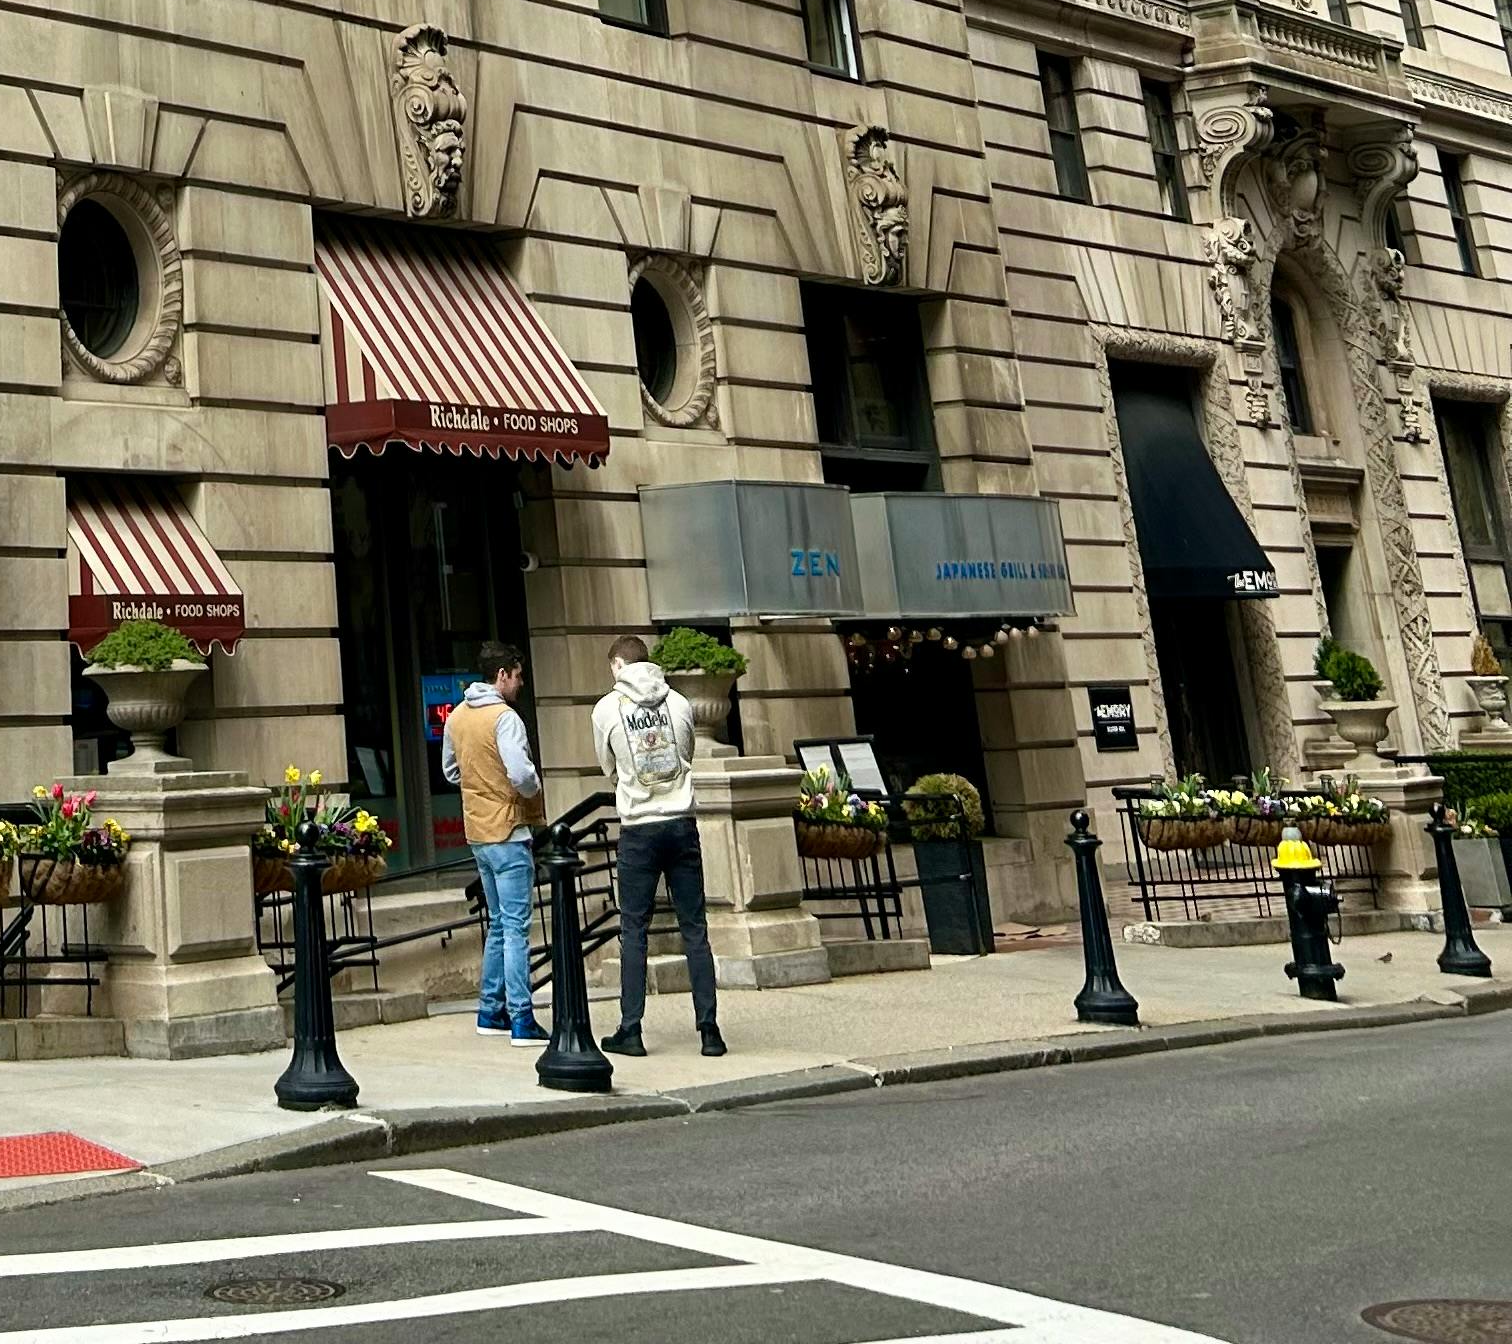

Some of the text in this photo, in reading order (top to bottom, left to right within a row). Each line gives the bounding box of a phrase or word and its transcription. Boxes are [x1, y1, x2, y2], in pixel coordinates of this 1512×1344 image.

[430, 404, 579, 435] Richdale FOOD SHOPS
[791, 550, 840, 577] ZEN
[936, 562, 996, 580] JAPANESE
[112, 601, 240, 620] Richdale FOOD SHOPS
[626, 710, 668, 731] Modelo
